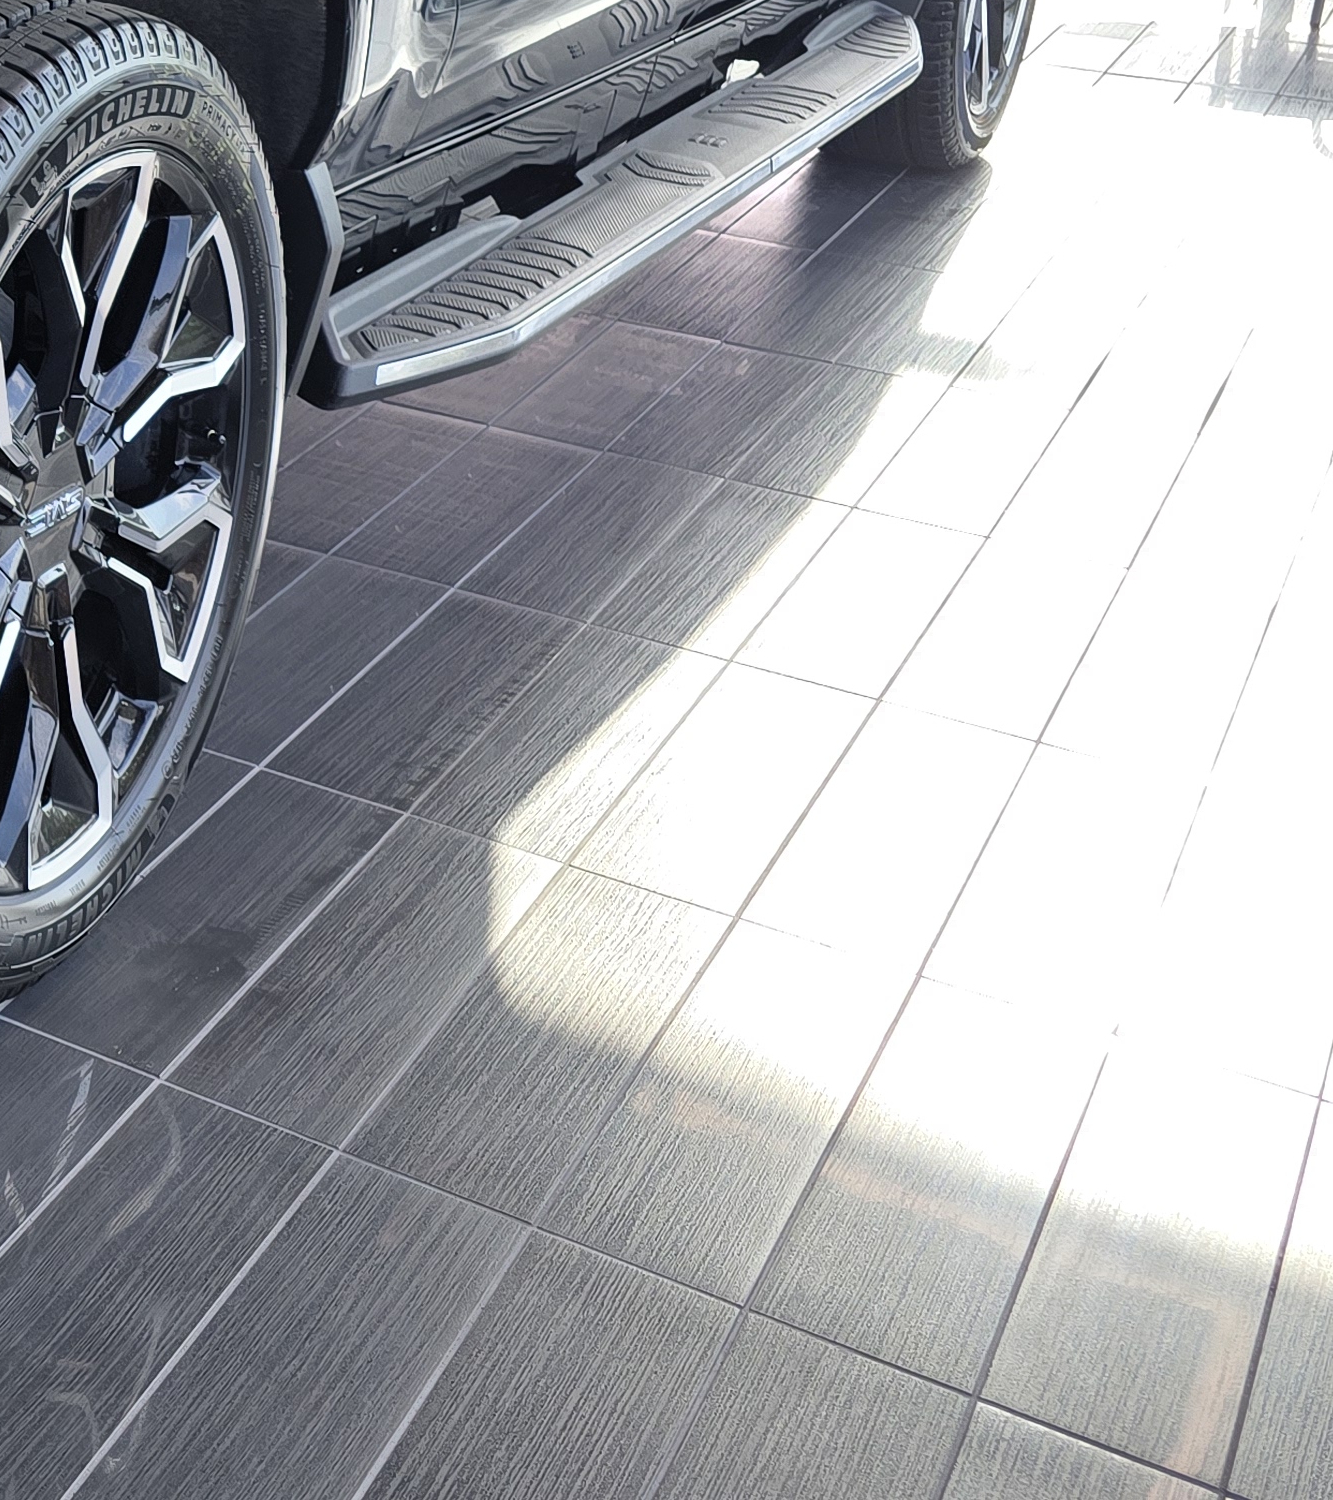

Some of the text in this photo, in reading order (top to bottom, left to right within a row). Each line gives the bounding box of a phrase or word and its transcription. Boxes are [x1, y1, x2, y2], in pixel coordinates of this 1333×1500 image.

[66, 87, 190, 164] MICHELIN
[200, 101, 238, 143] PRIMACY
[23, 841, 143, 960] MICHELIN
